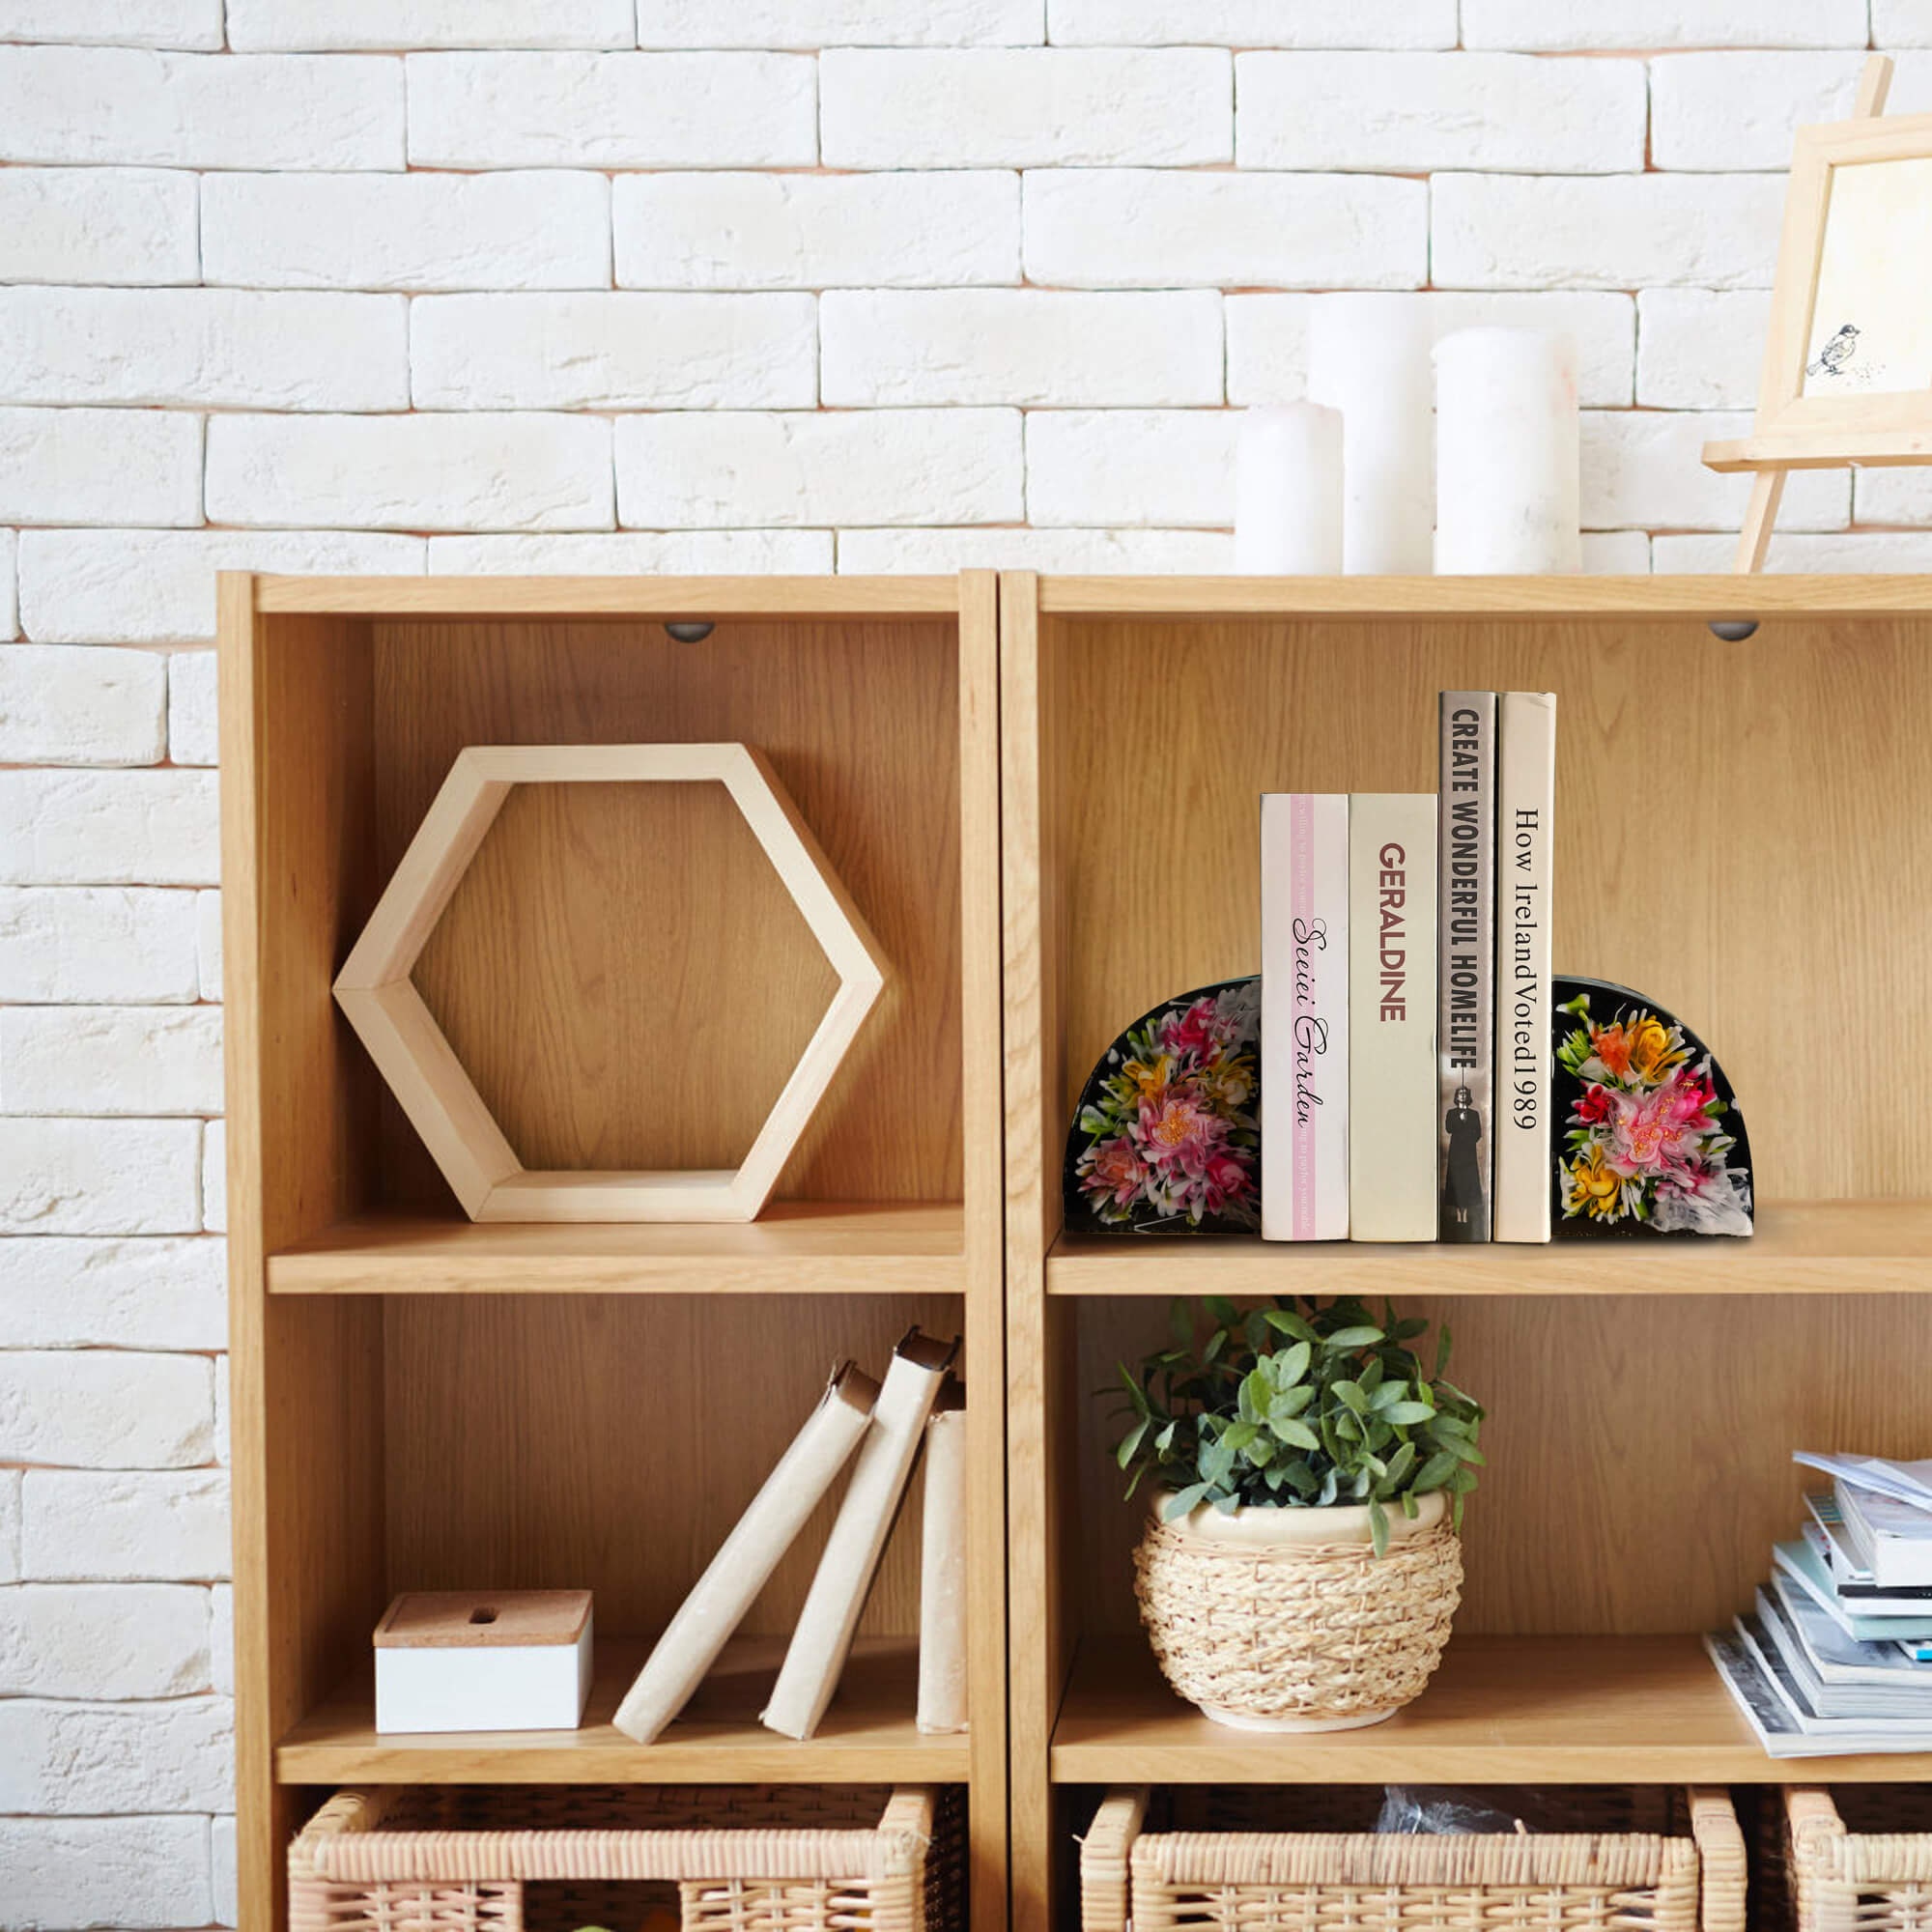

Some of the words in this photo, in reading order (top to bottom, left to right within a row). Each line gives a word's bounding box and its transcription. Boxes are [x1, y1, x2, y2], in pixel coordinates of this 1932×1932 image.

[1452, 708, 1479, 792] CREATE
[1451, 800, 1479, 946] WONDERFUL
[1515, 808, 1539, 872] How
[1379, 842, 1406, 1022] GERALDINE
[1451, 954, 1478, 1069] HOMELIFE
[1293, 1015, 1328, 1128] Garden
